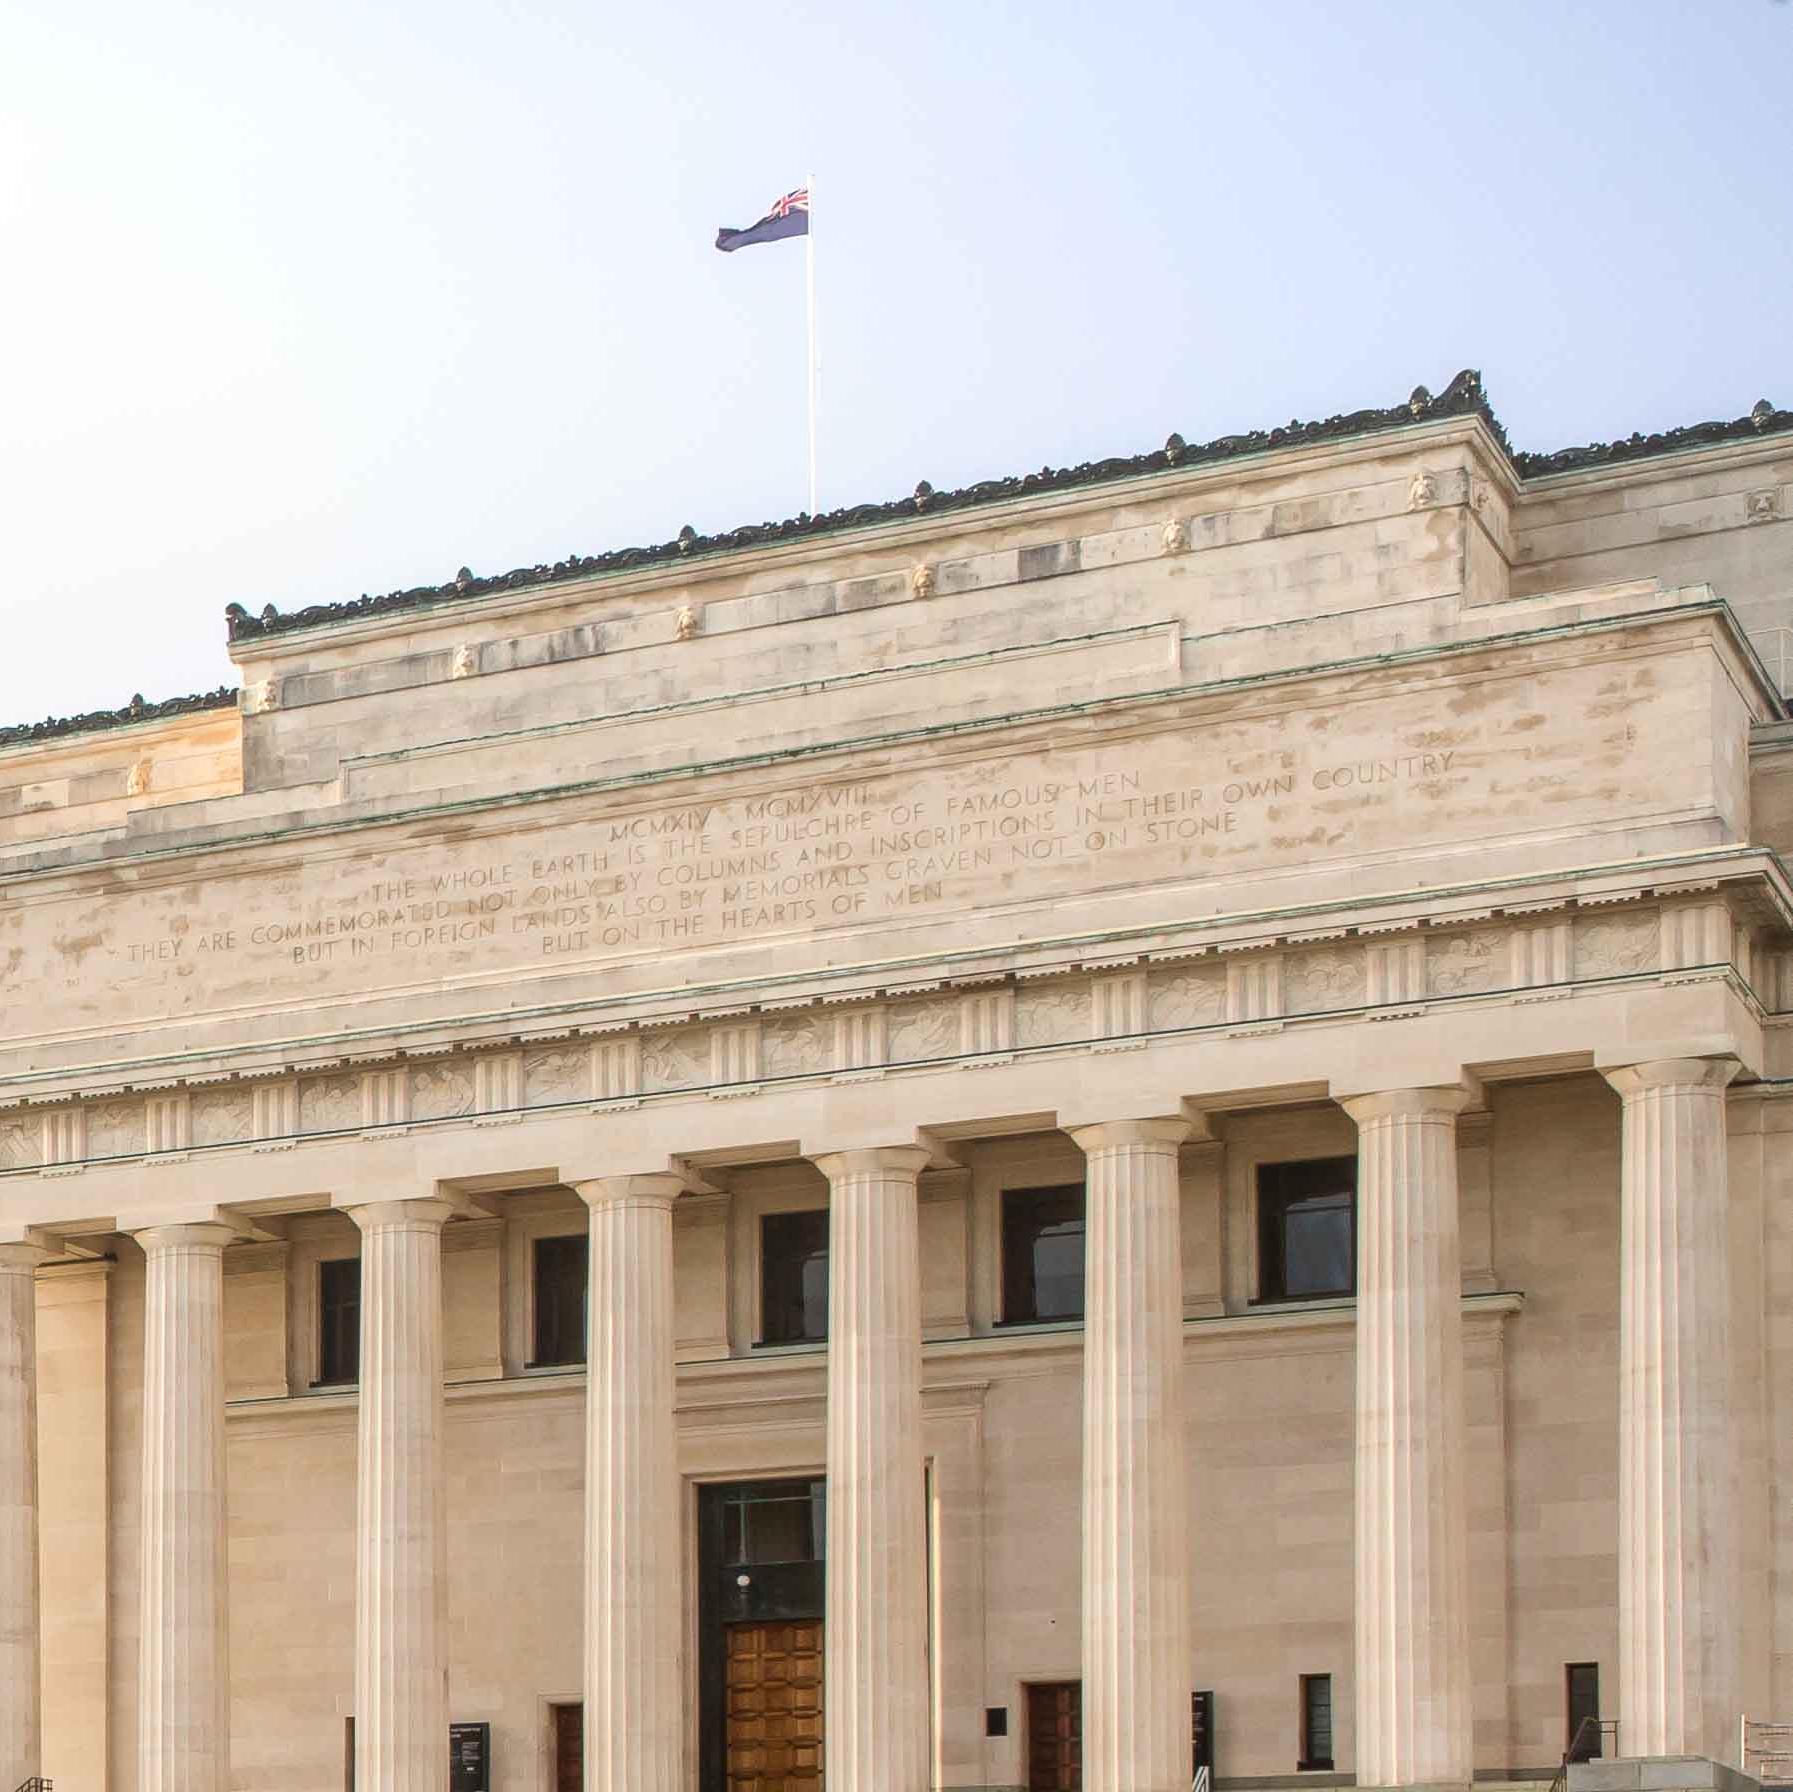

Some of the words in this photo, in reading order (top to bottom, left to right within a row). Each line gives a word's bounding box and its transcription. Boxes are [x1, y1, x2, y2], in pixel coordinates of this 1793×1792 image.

[127, 939, 182, 962] THEY
[198, 931, 238, 953] ARE
[252, 900, 449, 945] COMMEMORATED
[468, 888, 517, 915] NOT
[533, 878, 596, 905] ONLY
[617, 872, 642, 894] BY
[657, 851, 782, 886] COLUMNS
[797, 841, 854, 866] AND
[871, 810, 1055, 852] INSCRIPTIONS
[1077, 803, 1103, 827] IN
[1125, 788, 1203, 818] THEIR
[1223, 775, 1294, 804] OWN
[1312, 751, 1455, 791] COUNTRY
[293, 940, 335, 965] BUT
[352, 935, 375, 956] IN
[391, 917, 496, 948] FOREIGN
[512, 904, 591, 933] LANDS
[605, 894, 667, 921] ALSO
[680, 888, 706, 910] BY
[723, 865, 870, 904] MEMORIALS
[885, 848, 992, 881] GRAVEN
[1012, 836, 1065, 861] NOT
[1085, 828, 1127, 850] ON
[1147, 811, 1237, 843] STONE
[372, 878, 415, 903] THE
[432, 864, 513, 892] WHOLE
[532, 850, 608, 879] EARTH
[628, 844, 646, 866] IS
[665, 834, 712, 859] THE
[731, 810, 872, 848] SEPULCHRE
[890, 802, 925, 825] OF
[947, 784, 1055, 816] FAMOUS
[1078, 770, 1140, 799] MEN
[609, 807, 712, 843] MCMXIV
[542, 930, 585, 954] BUT
[602, 922, 640, 946] ON
[656, 914, 704, 938] THE
[722, 900, 816, 930] HEARTS
[832, 892, 867, 915] OF
[885, 880, 942, 906] MEN
